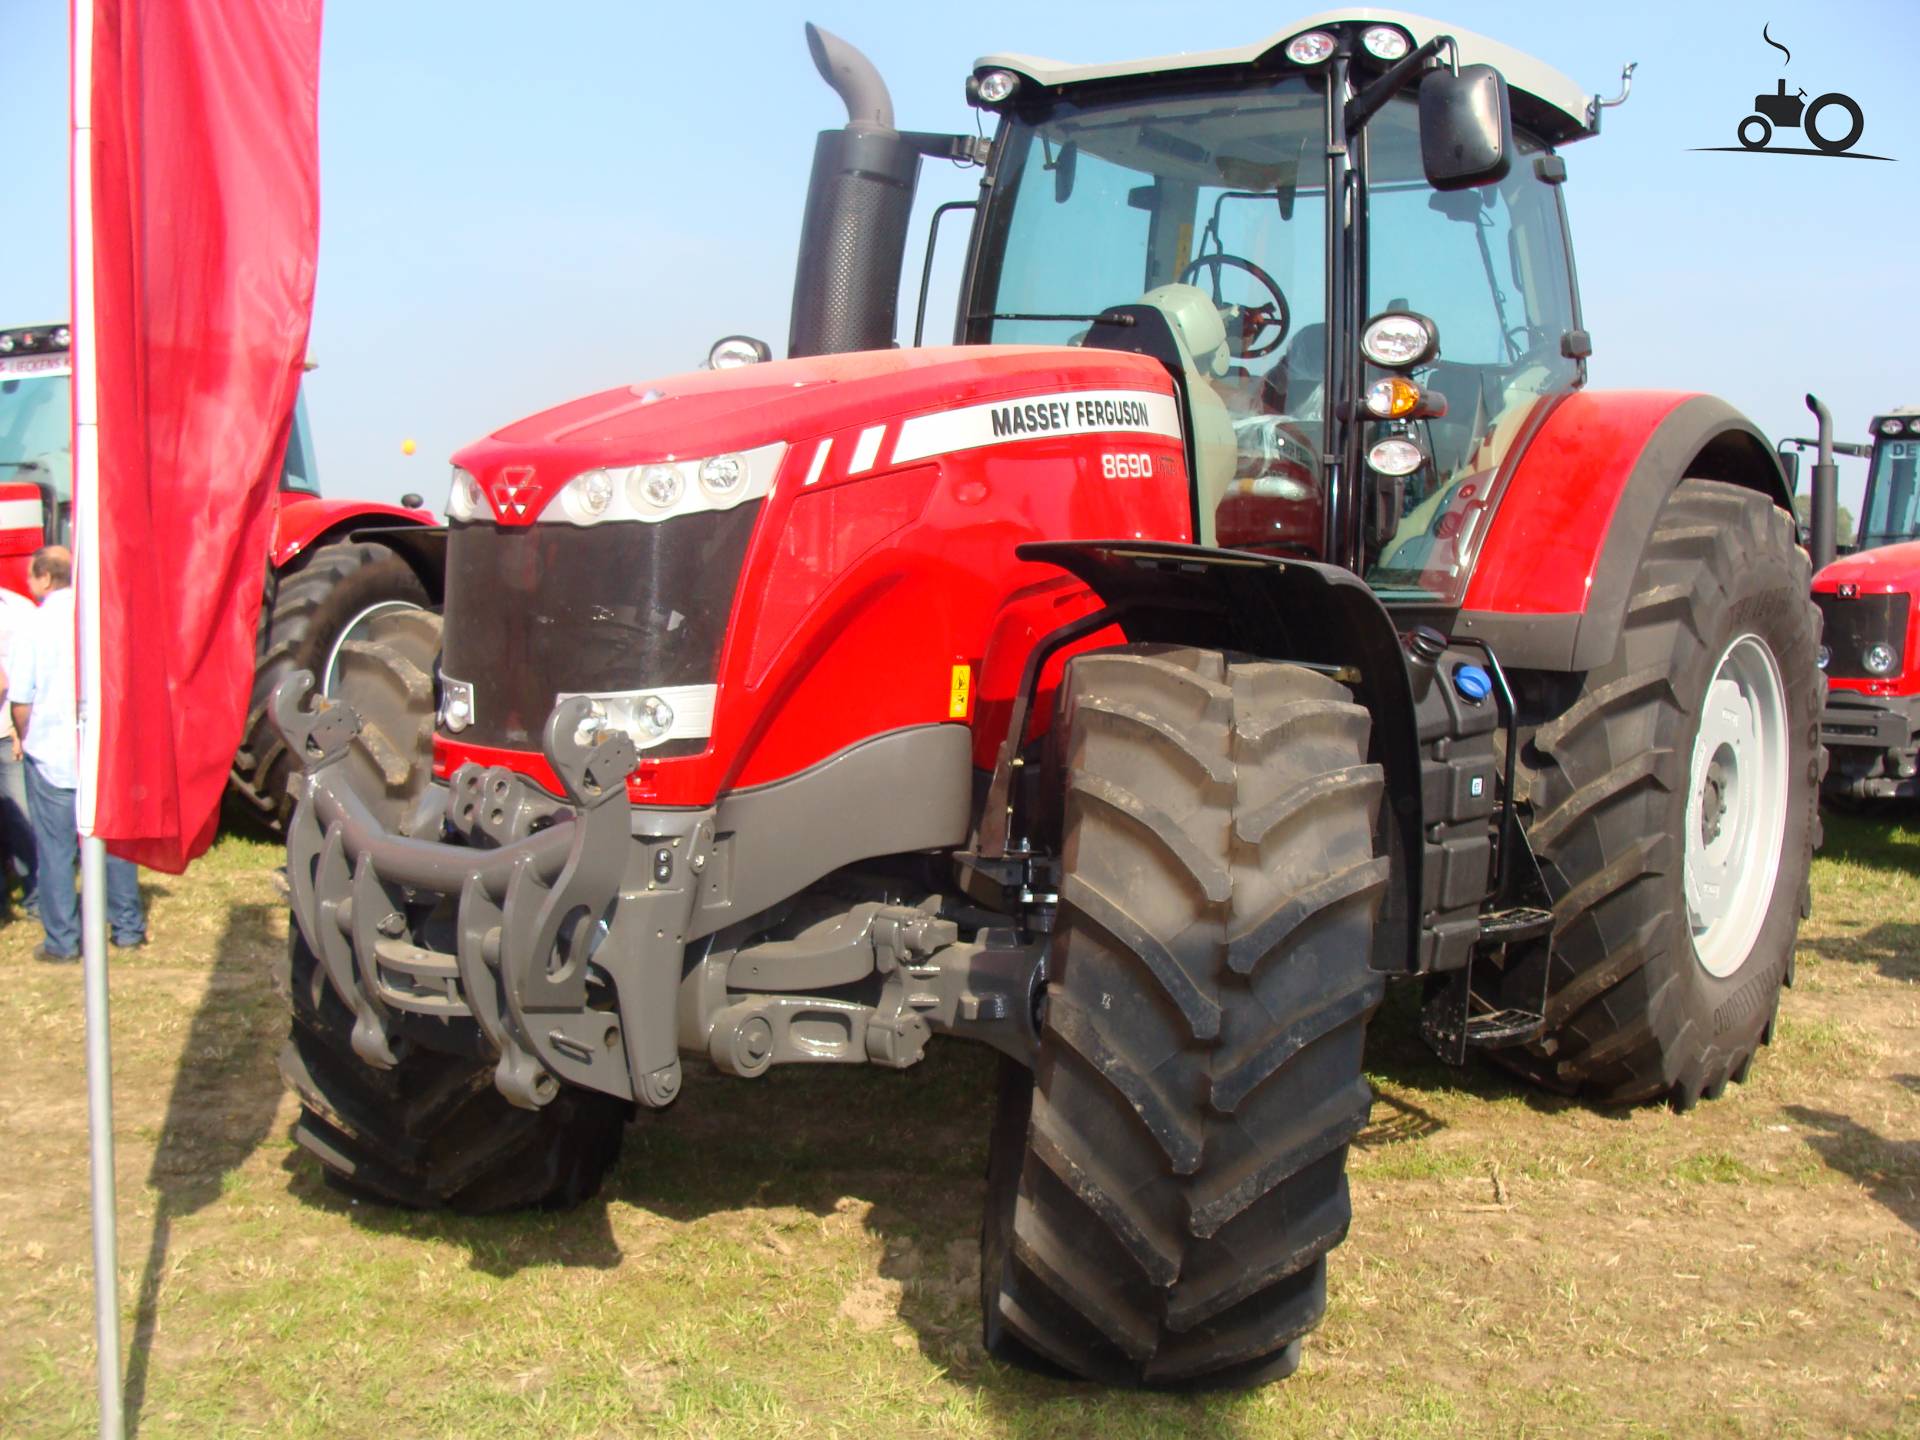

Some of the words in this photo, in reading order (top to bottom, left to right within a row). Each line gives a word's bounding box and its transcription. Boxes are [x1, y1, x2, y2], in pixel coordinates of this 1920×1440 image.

[991, 402, 1070, 437] MASSEY
[1076, 400, 1150, 428] FERGUSON
[1101, 453, 1153, 479] 8690
